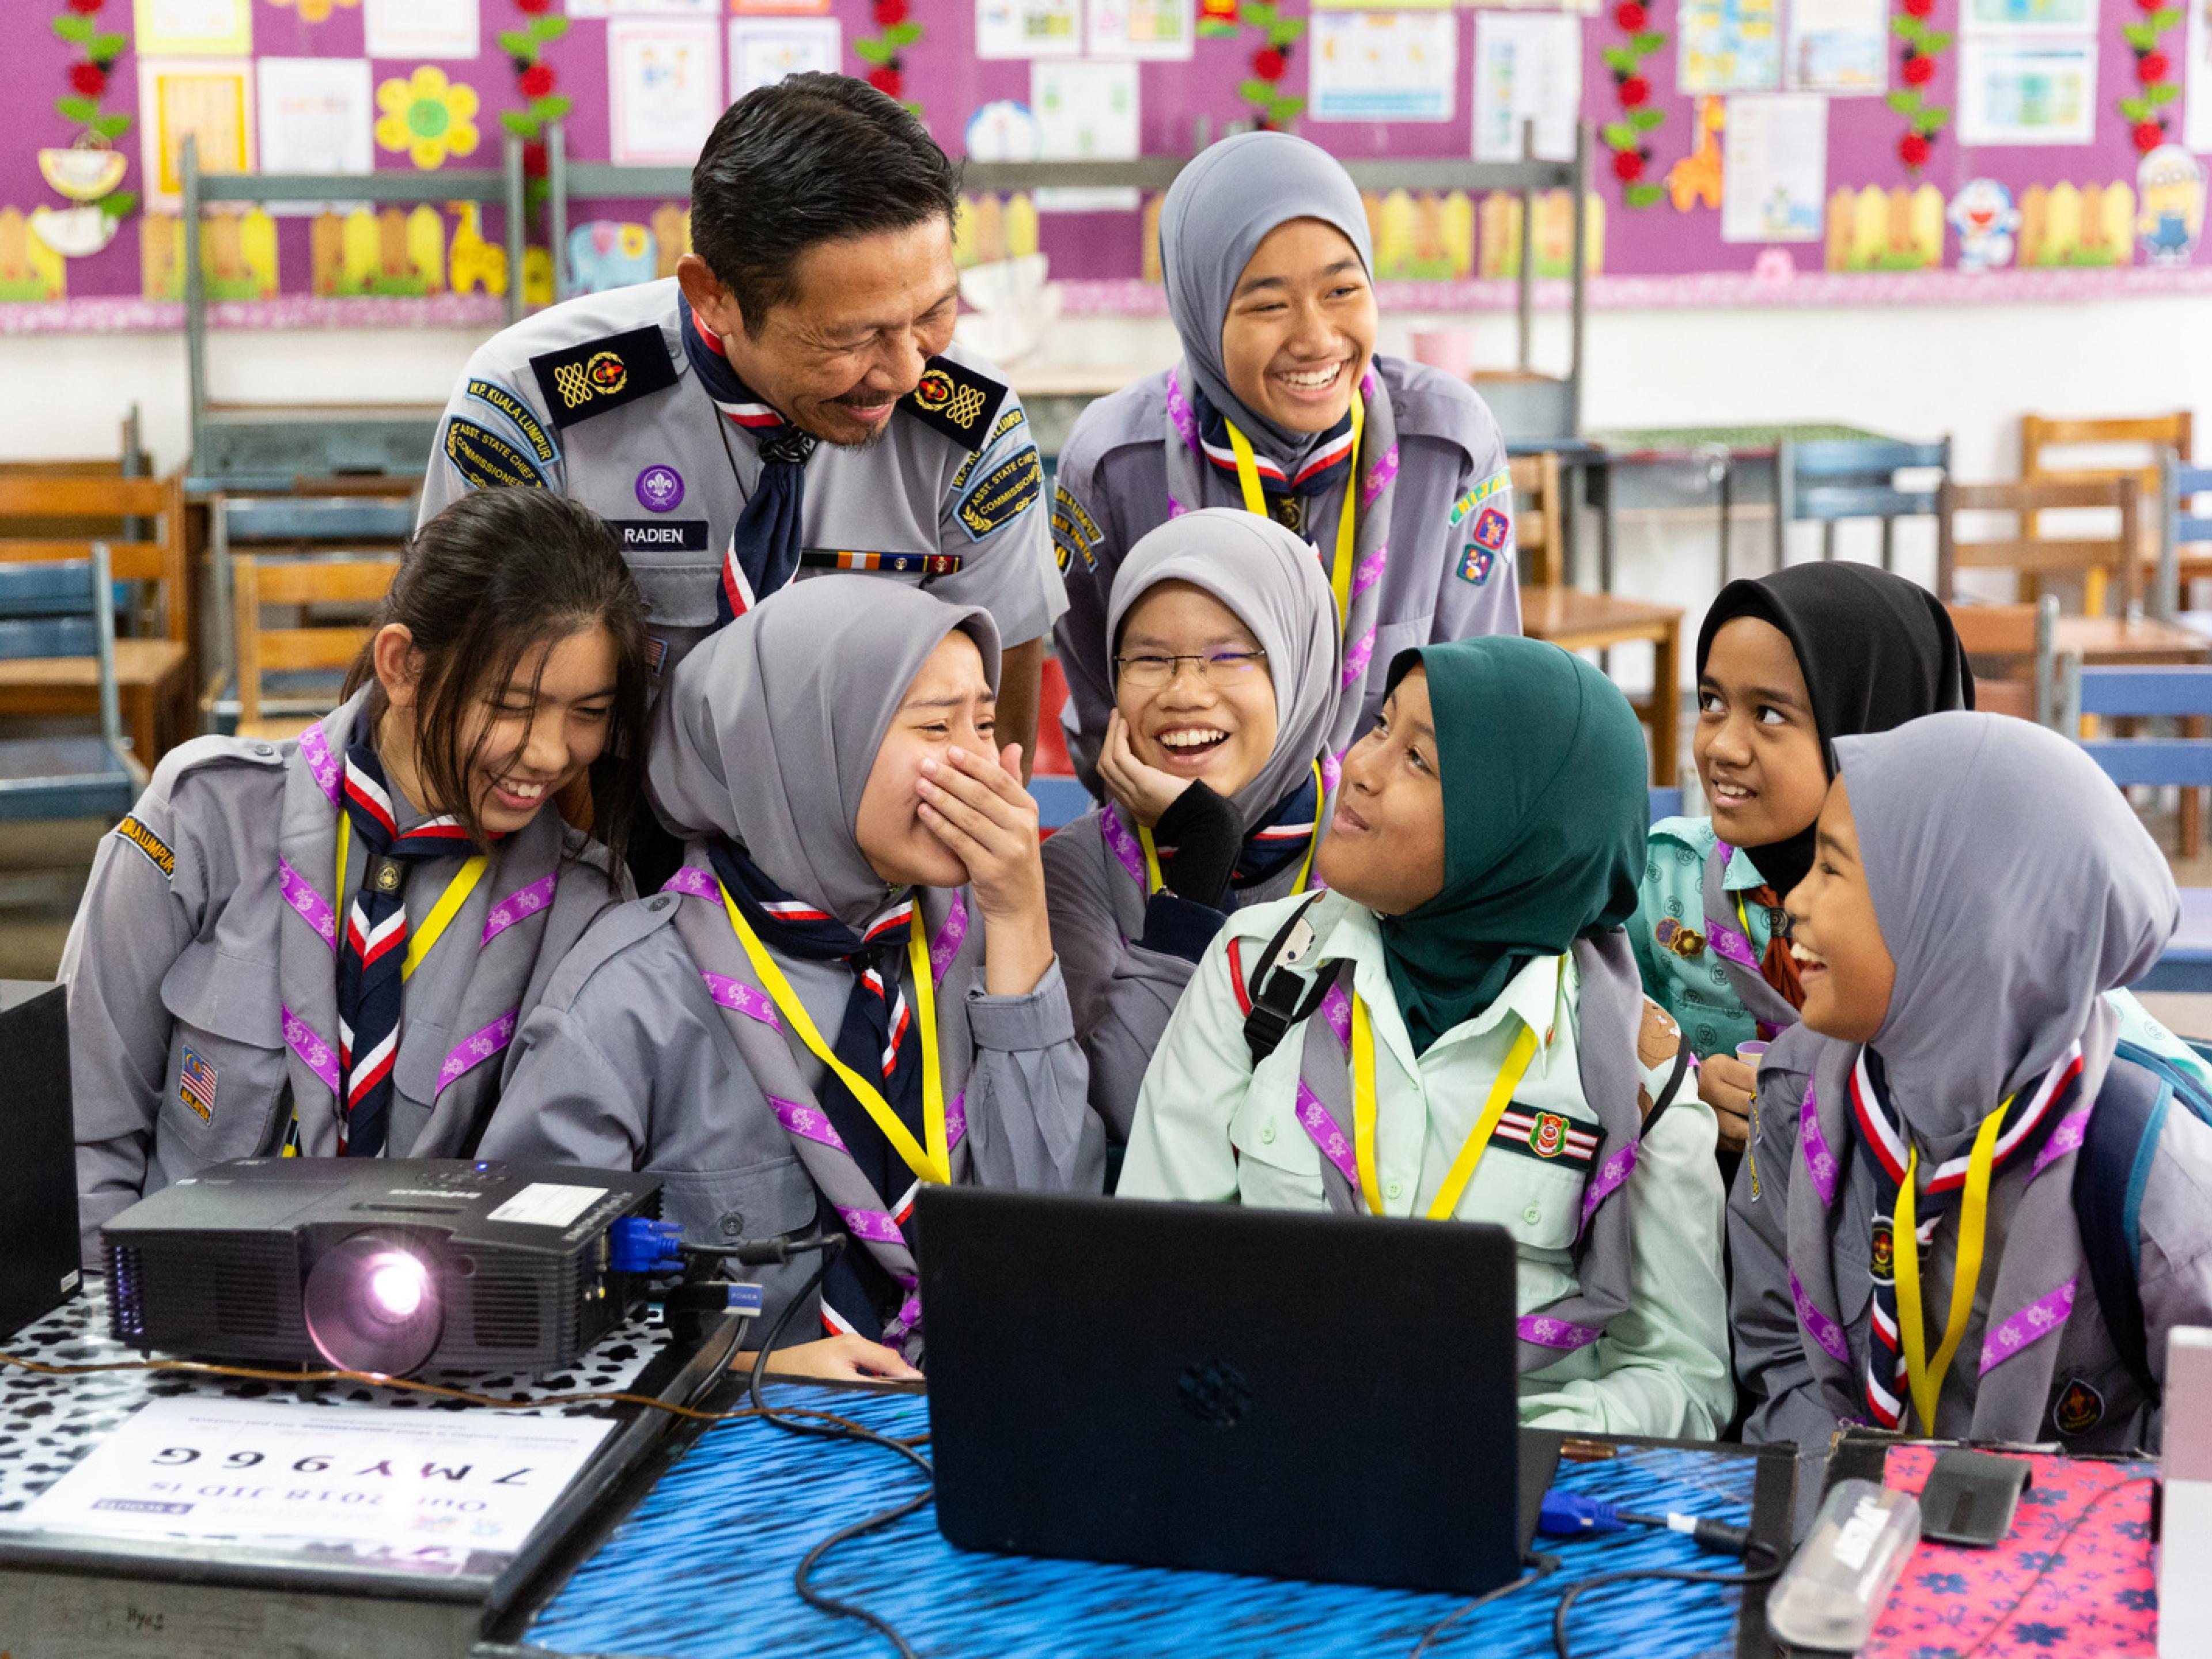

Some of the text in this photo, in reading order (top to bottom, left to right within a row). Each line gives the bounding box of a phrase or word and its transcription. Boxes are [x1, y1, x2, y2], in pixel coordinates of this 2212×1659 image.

[487, 388, 521, 419] KUALA
[518, 414, 551, 461] LUMPUR
[482, 435, 512, 457] STATE
[510, 455, 536, 479] CHIEF
[992, 461, 1017, 484] STATE
[624, 522, 683, 543] RADIEN
[148, 1482, 183, 1494] is
[198, 1484, 274, 1499] JID
[285, 1486, 384, 1507] 2018
